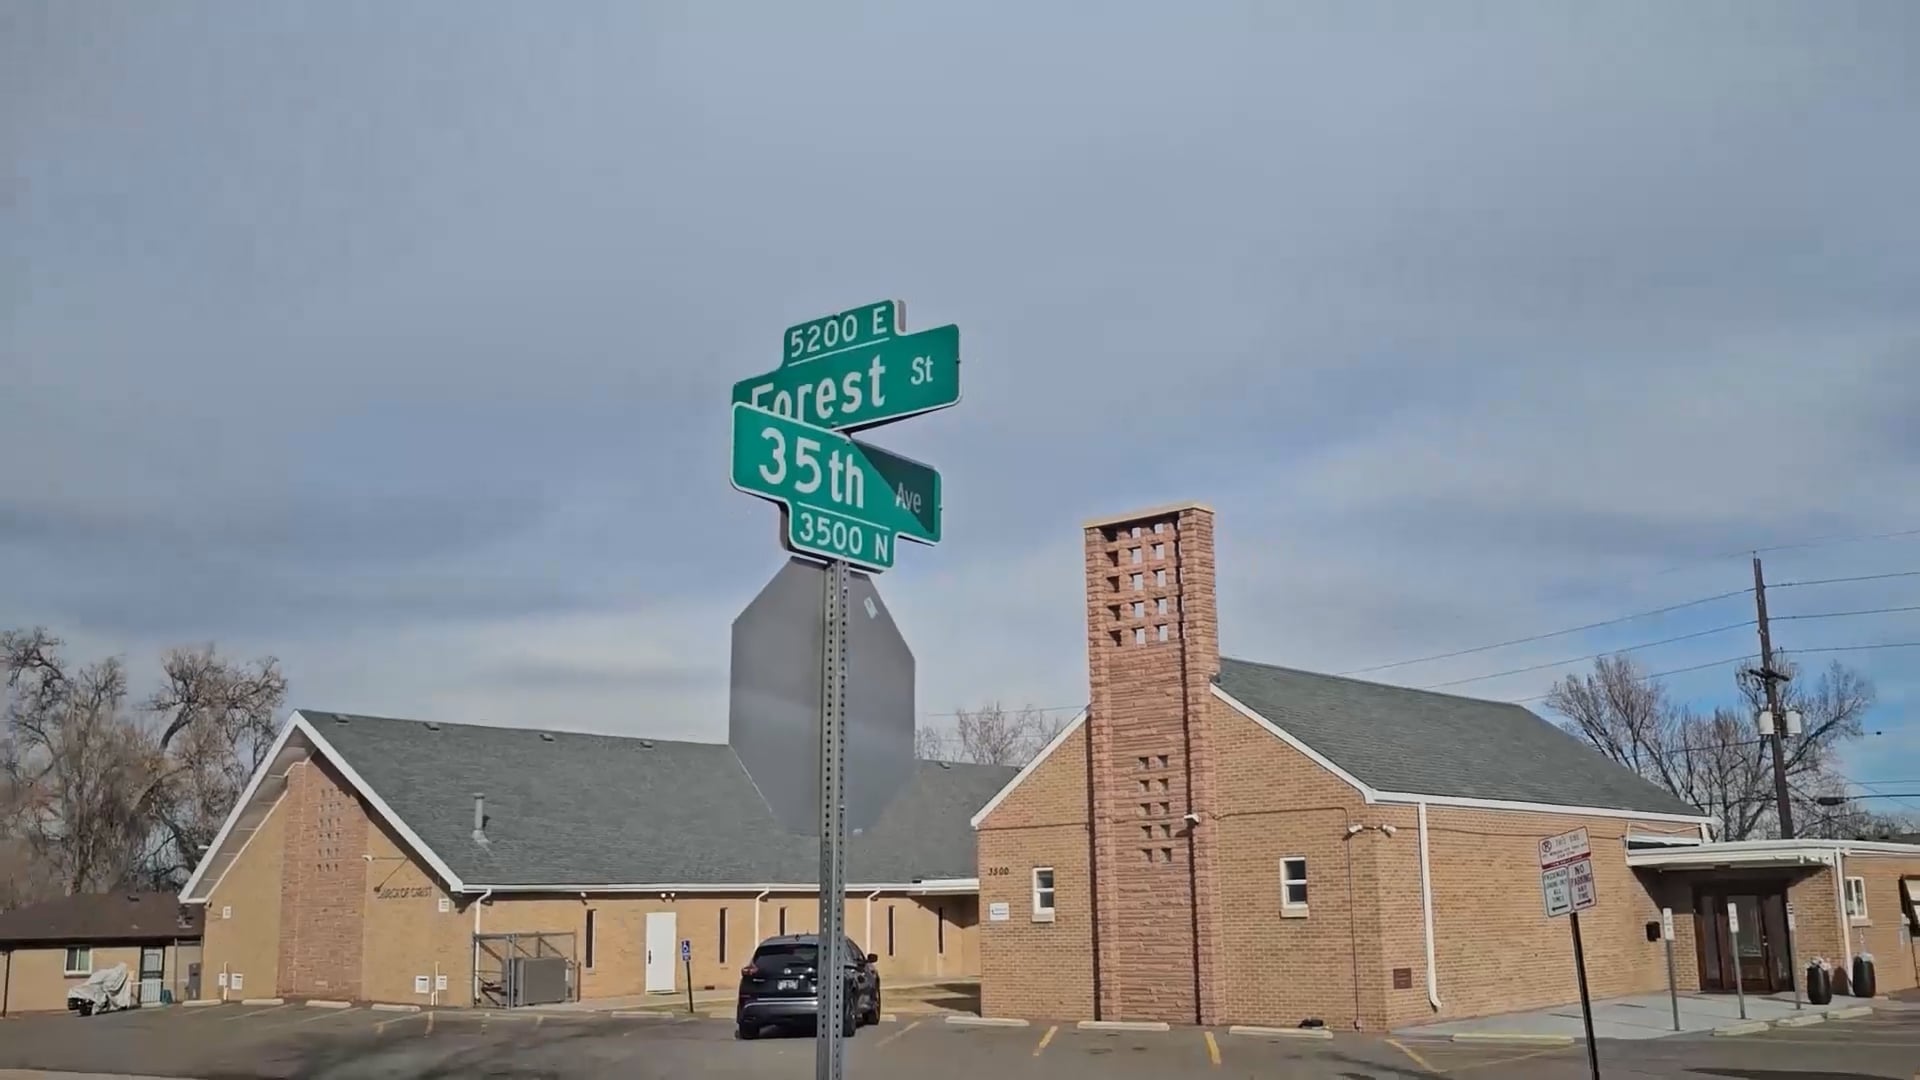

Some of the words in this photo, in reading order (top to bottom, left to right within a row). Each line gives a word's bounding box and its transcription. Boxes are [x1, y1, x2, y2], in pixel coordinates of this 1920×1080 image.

[791, 314, 857, 358] 5200
[873, 305, 887, 335] E
[751, 354, 886, 424] Forest
[910, 355, 934, 385] St
[758, 427, 864, 509] 35th
[895, 482, 922, 513] Ave
[799, 512, 863, 555] 3500
[875, 532, 888, 562] N
[988, 867, 1009, 876] 3500
[1574, 864, 1585, 875] NO
